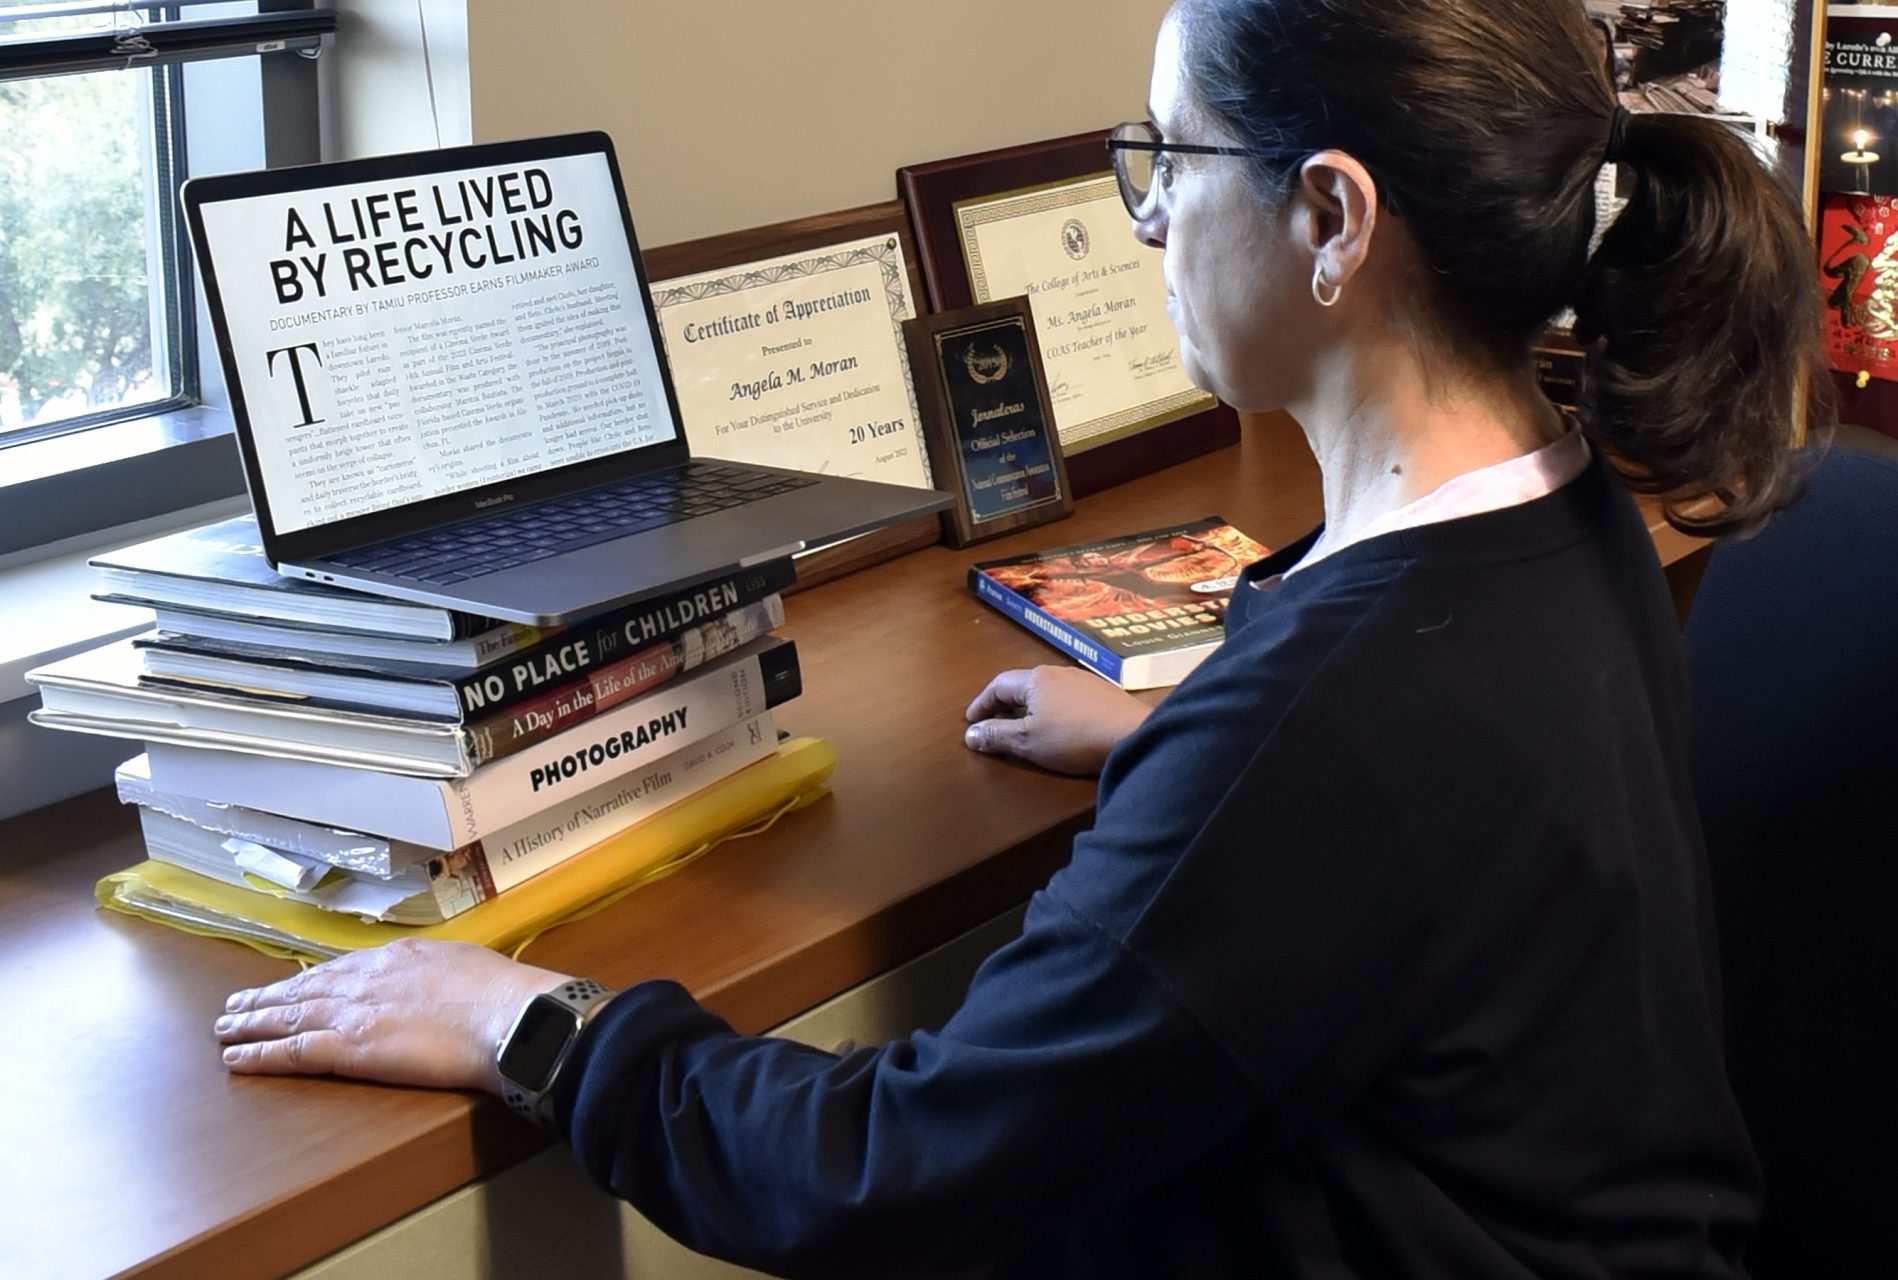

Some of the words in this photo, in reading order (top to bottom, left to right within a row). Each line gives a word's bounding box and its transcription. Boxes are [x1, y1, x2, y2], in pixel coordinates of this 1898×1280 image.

[1836, 52, 1897, 69] CURRE
[285, 207, 316, 252] A
[324, 188, 424, 246] LIFE
[432, 168, 554, 226] LIVED
[269, 252, 328, 306] BY
[343, 209, 585, 291] RECYCLING
[1024, 282, 1040, 297] The
[1041, 275, 1071, 293] College
[1070, 272, 1081, 287] of
[1081, 267, 1101, 282] Arts
[1109, 258, 1141, 276] Sciences
[269, 304, 354, 332] DOCUMENTARY
[355, 301, 370, 318] BY
[370, 293, 405, 313] TAMIU
[407, 283, 468, 305] PROFESSOR
[470, 277, 505, 294] EARNS
[506, 265, 563, 289] FILMMAKER
[565, 256, 600, 276] AWARD
[683, 310, 762, 344] Certificate
[766, 305, 780, 325] of
[783, 286, 872, 322] Appreciation
[1046, 315, 1065, 330] Ms.
[1067, 303, 1101, 326] Angela
[1103, 297, 1137, 316] Moran
[761, 337, 802, 357] Presented
[804, 337, 813, 346] to
[1071, 335, 1105, 354] Teacher
[1105, 331, 1115, 346] of
[1115, 328, 1127, 341] the
[1127, 323, 1149, 340] Year
[728, 370, 783, 401] Angela
[786, 367, 806, 384] M.
[809, 354, 859, 381] Moran
[715, 422, 729, 436] For
[730, 418, 750, 433] Your
[750, 405, 801, 429] Distinguished
[801, 398, 829, 416] Service
[829, 394, 843, 409] and
[842, 383, 881, 404] Dedication
[773, 422, 781, 434] to
[781, 418, 795, 433] the
[796, 410, 833, 429] University
[850, 426, 865, 445] 20
[868, 417, 905, 440] Years
[464, 677, 504, 712] NO
[513, 640, 590, 692] PLACE
[597, 628, 620, 661] for
[624, 581, 739, 646] CHILDREN
[479, 639, 499, 657] The
[1024, 606, 1073, 646] UNDERSTANDING
[1073, 637, 1099, 664] MOVIES
[1101, 613, 1217, 638] MOVIES
[512, 719, 525, 740] A
[525, 709, 554, 734] Day
[556, 699, 572, 717] in
[573, 690, 594, 713] the
[595, 675, 621, 701] Life
[623, 669, 637, 687] of
[639, 662, 658, 682] the
[530, 706, 689, 793] PHOTOGRAPHY
[459, 780, 478, 841] WARREN
[502, 846, 513, 866] A
[513, 824, 565, 859] History
[566, 811, 582, 833] of
[582, 784, 643, 829] Narrative
[643, 770, 673, 797] Film
